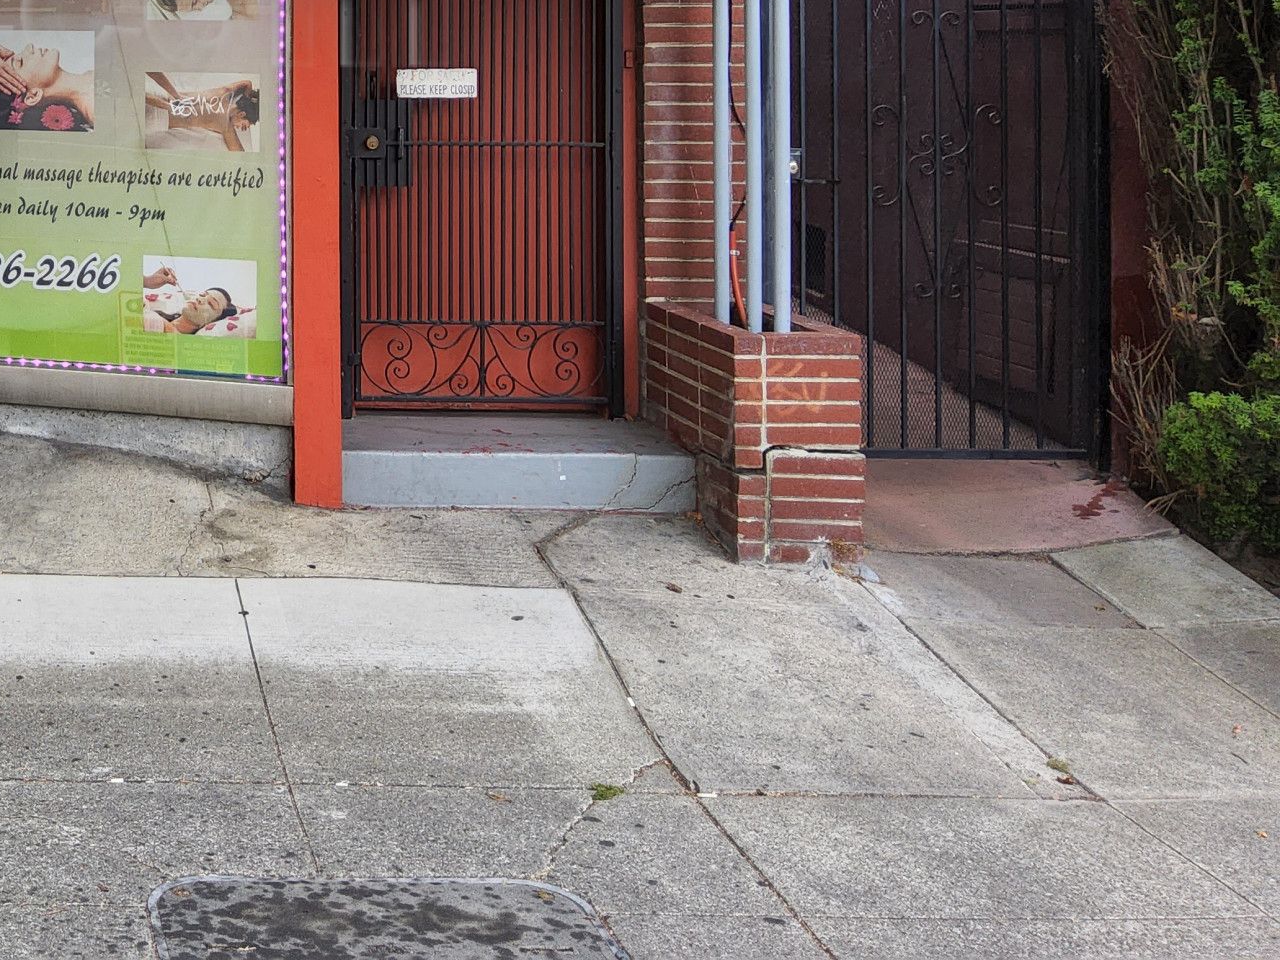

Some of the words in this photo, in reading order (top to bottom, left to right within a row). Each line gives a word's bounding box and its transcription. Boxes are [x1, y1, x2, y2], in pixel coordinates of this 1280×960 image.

[400, 84, 427, 95] PLEASE
[429, 84, 448, 95] KEEP
[450, 84, 475, 95] CLOSED
[23, 166, 84, 189] massage
[87, 164, 163, 191] therapists
[167, 172, 192, 187] are
[197, 168, 265, 191] certified
[16, 195, 60, 222] daily
[64, 200, 110, 220] 10am
[128, 204, 167, 223] 9pm
